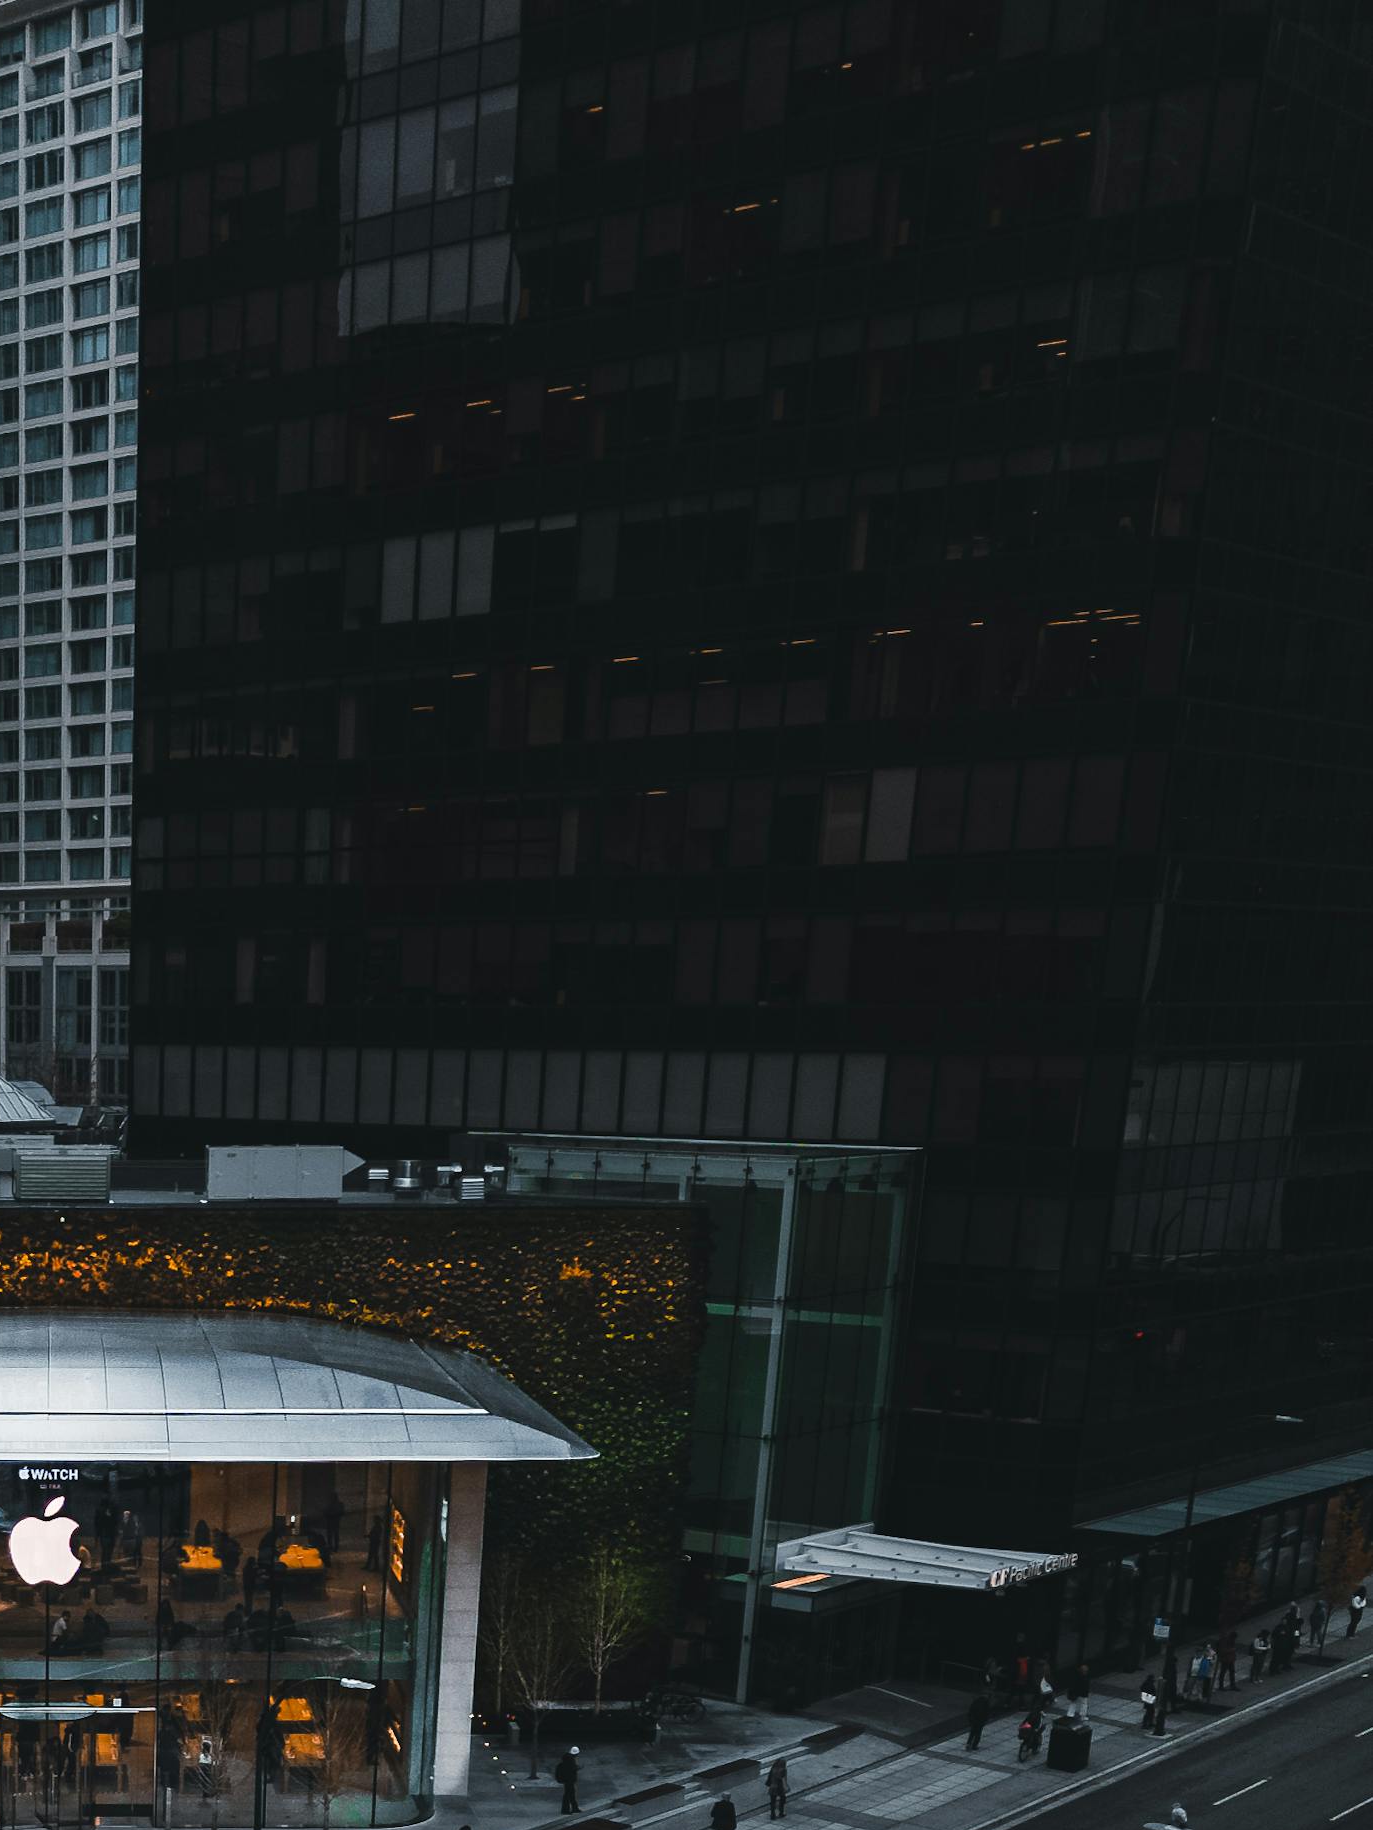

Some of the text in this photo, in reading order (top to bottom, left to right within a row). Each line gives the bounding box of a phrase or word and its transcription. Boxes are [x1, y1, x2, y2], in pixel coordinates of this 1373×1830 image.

[30, 1468, 79, 1481] WATCH
[1009, 1559, 1043, 1582] Pacific
[1044, 1552, 1079, 1573] Centre
